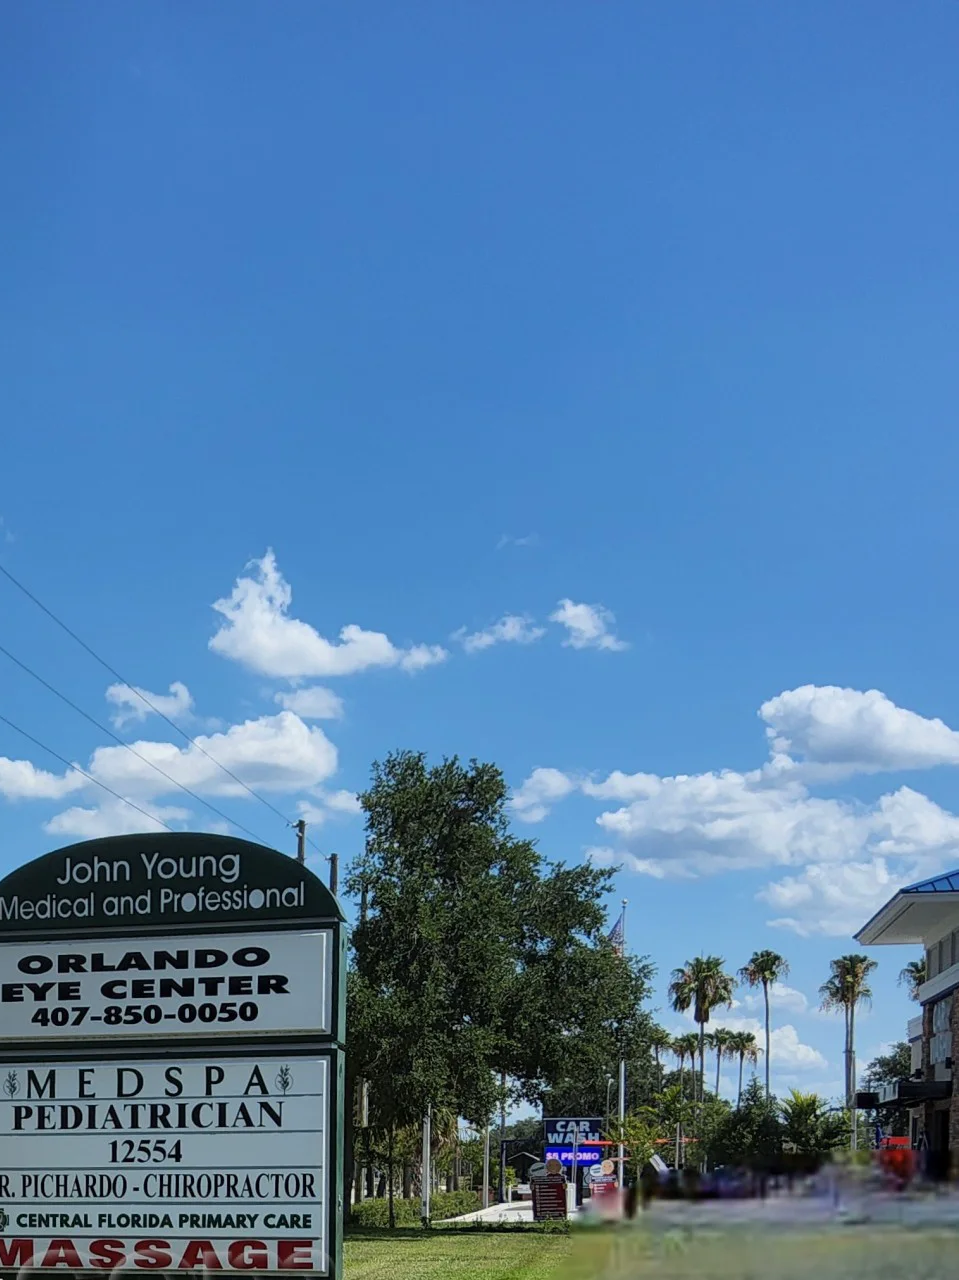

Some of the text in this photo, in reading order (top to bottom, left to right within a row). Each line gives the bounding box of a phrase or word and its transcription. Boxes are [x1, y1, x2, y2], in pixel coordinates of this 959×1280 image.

[57, 852, 240, 884] John Young
[102, 889, 151, 915] and
[160, 881, 304, 913] Professional
[18, 947, 270, 974] ORLANDO
[1, 974, 290, 1002] EYE CENTER
[32, 1001, 258, 1027] 407-850-0050
[12, 1101, 284, 1131] PEDIATRICIAN
[556, 1121, 590, 1131] CAR
[108, 1139, 182, 1163] 12554
[547, 1133, 599, 1144] WASH
[561, 1152, 599, 1160] PROMO
[21, 1173, 127, 1198] PICHARDO
[143, 1172, 316, 1198] CHIROPRACTOR
[16, 1213, 312, 1229] CENTRAL FLORIDA PRIMARY CARE
